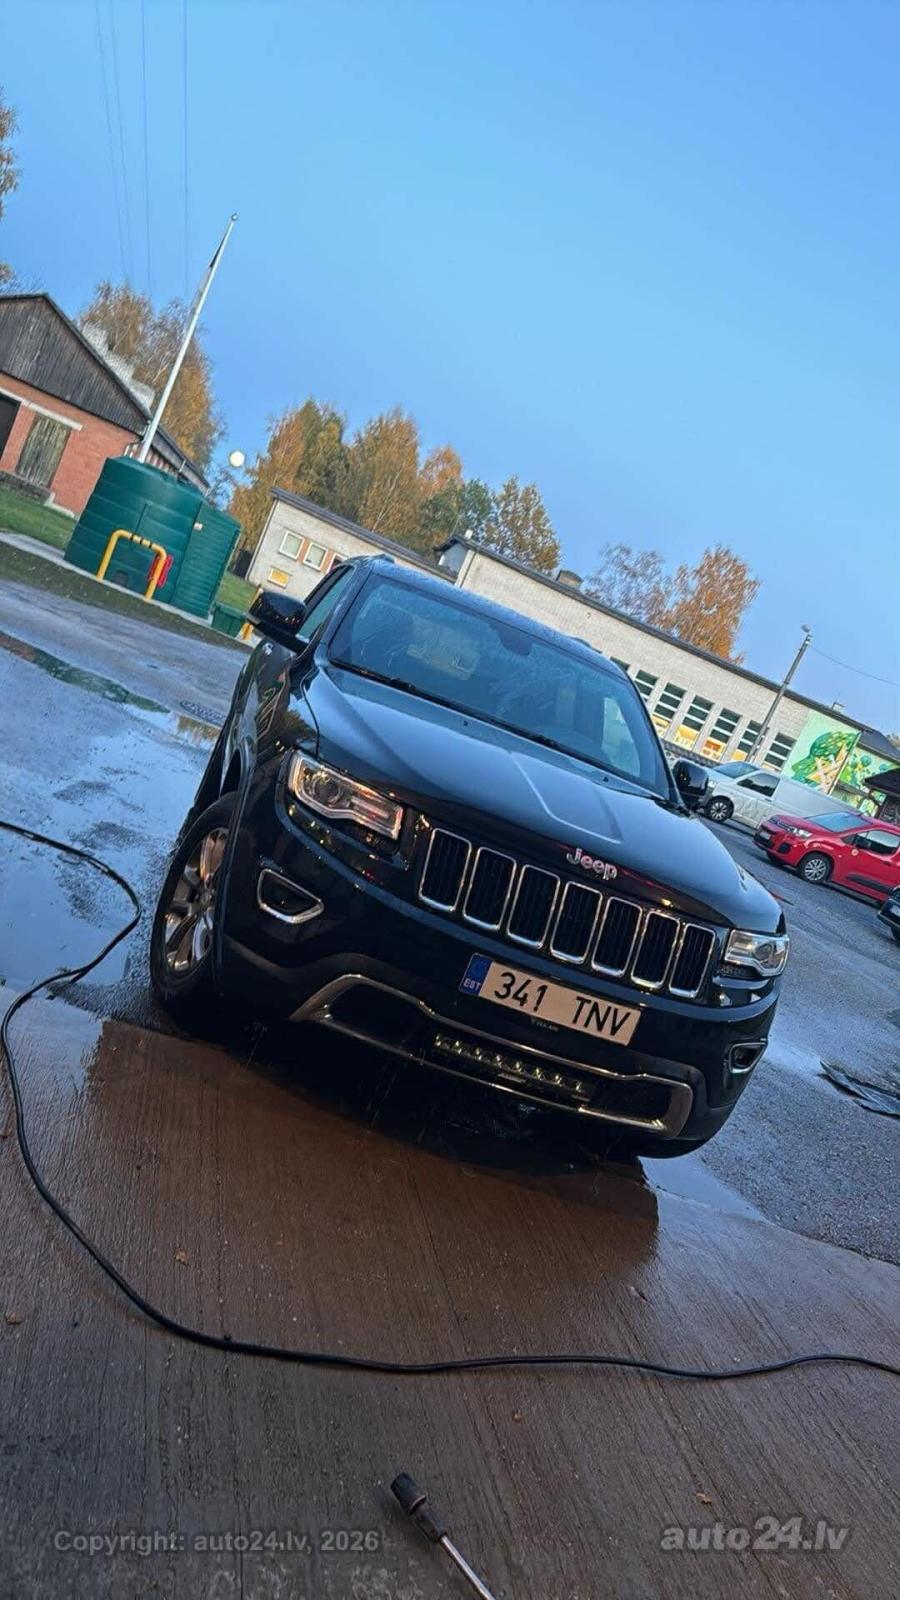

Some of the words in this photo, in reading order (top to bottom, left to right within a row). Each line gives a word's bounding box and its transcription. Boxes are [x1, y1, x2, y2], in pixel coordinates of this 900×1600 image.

[566, 848, 617, 880] Jeep
[463, 978, 481, 991] EST
[494, 972, 548, 1012] 341
[572, 996, 631, 1036] TNV
